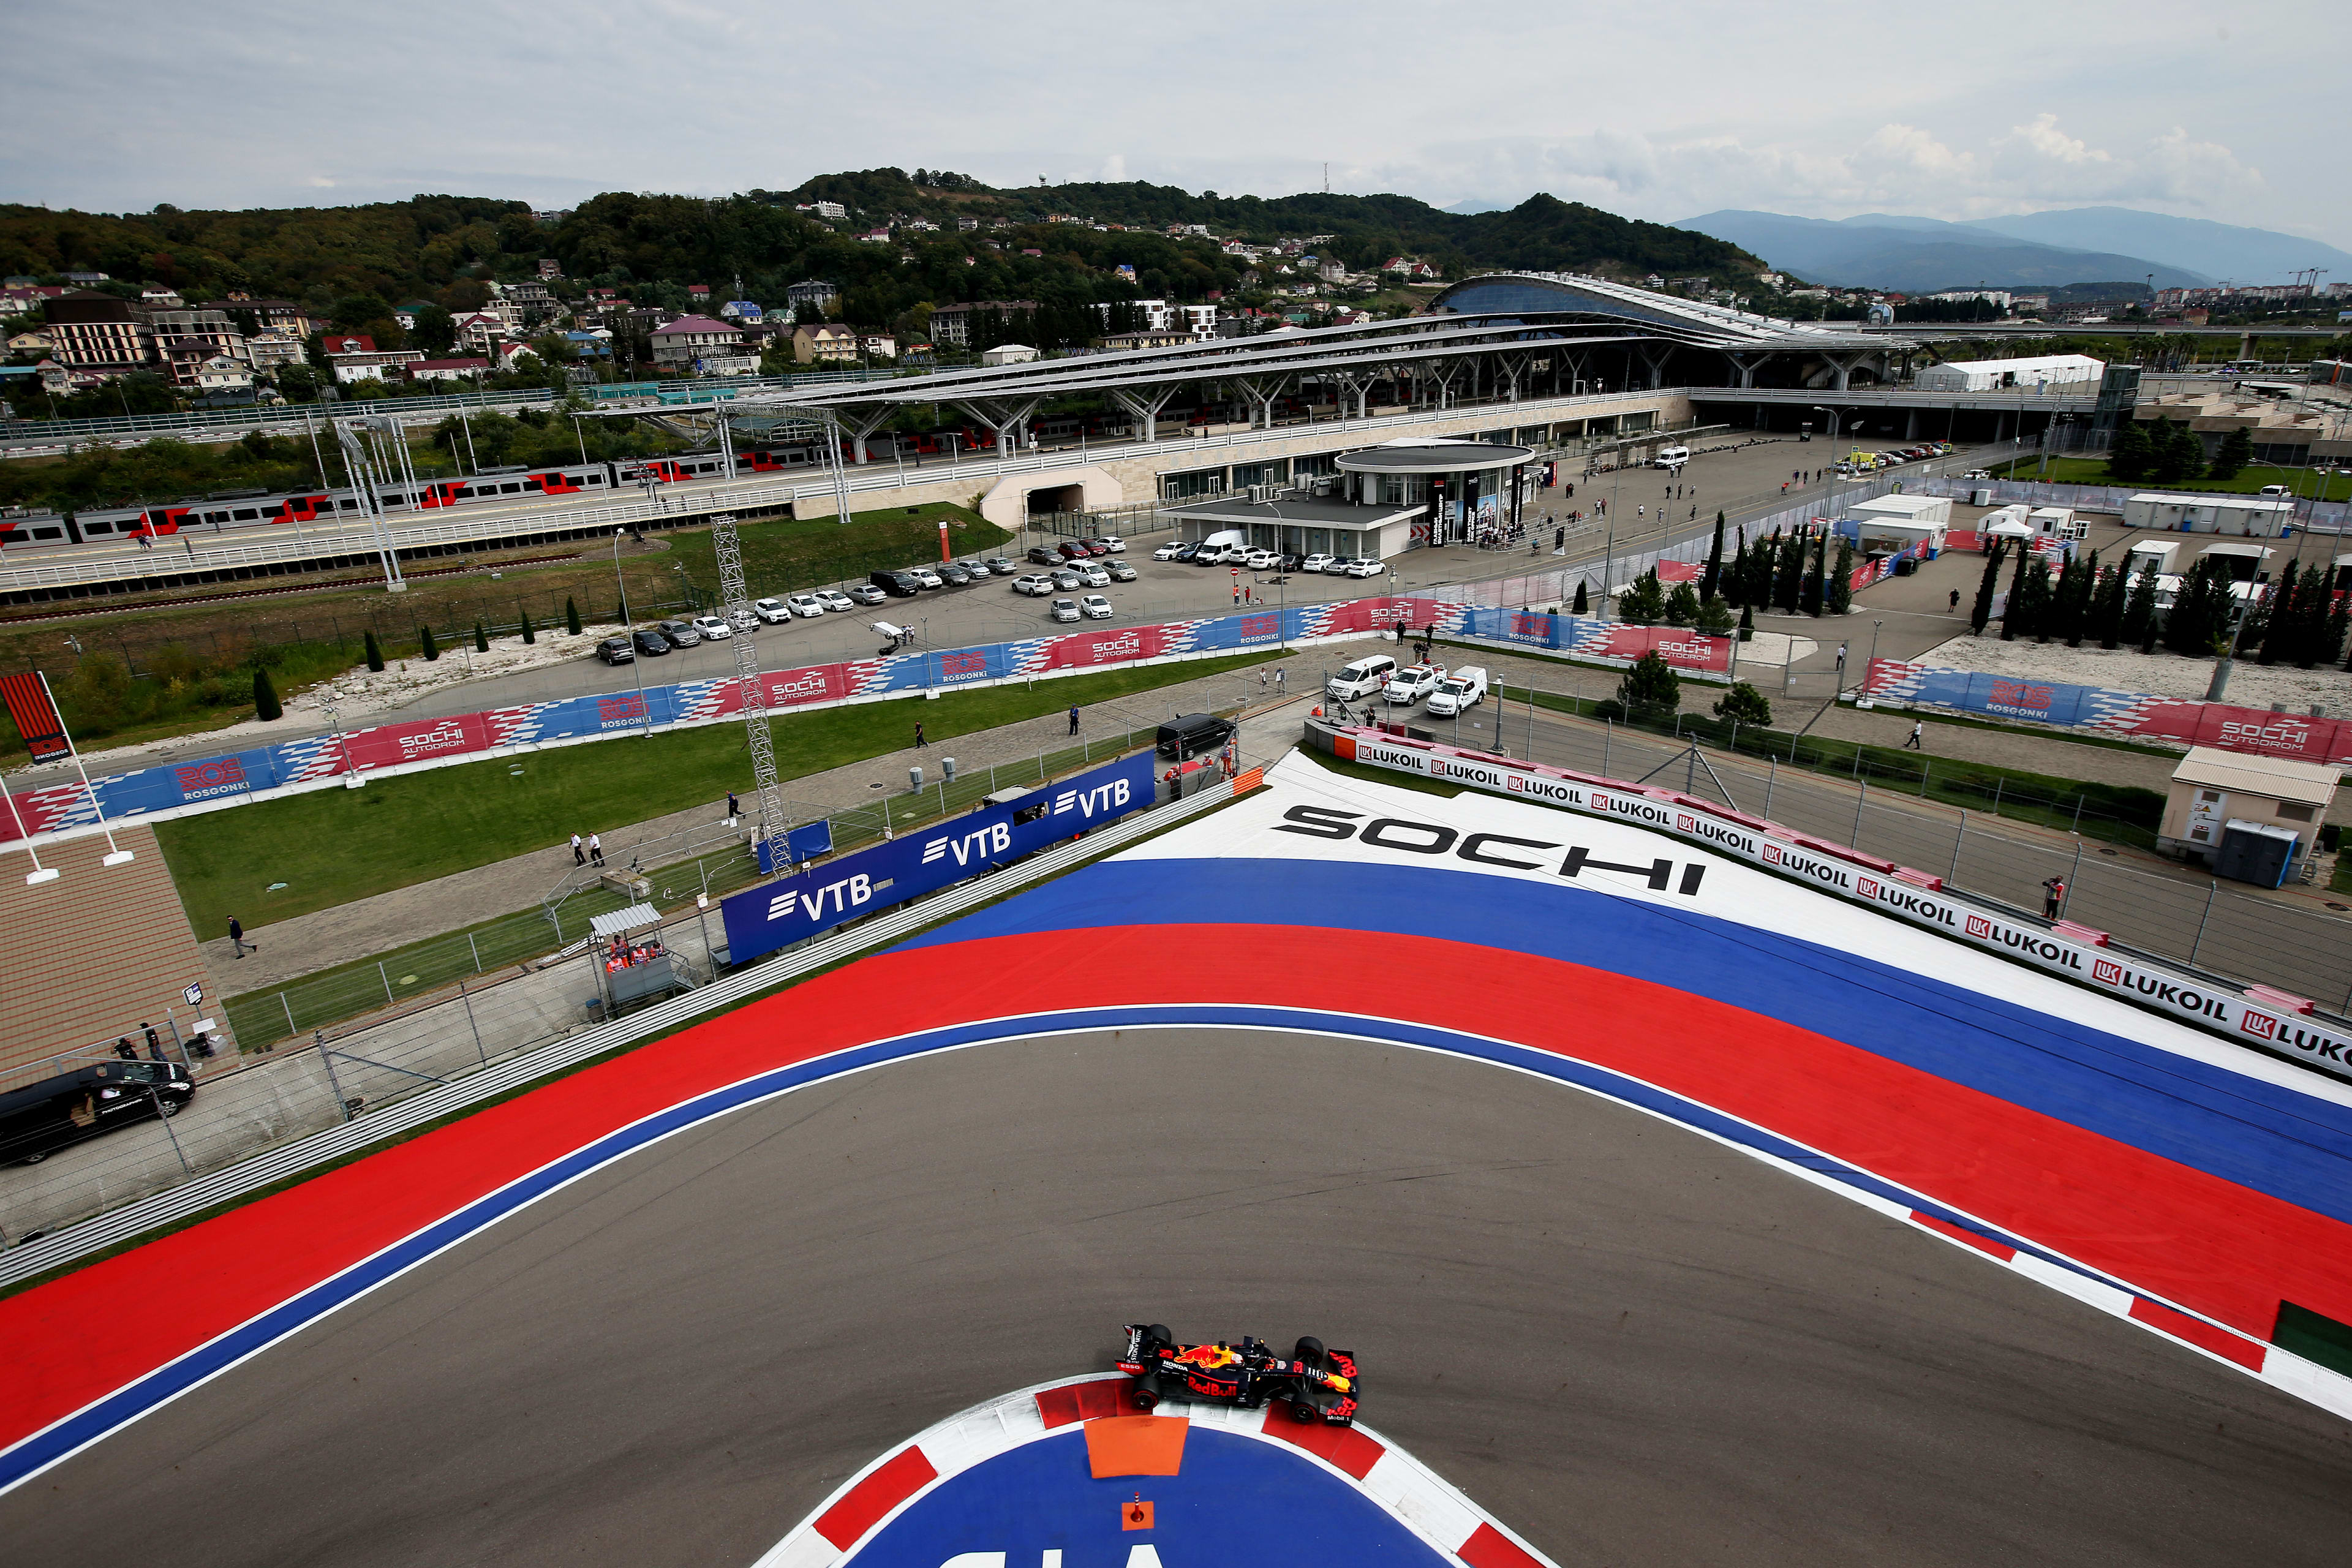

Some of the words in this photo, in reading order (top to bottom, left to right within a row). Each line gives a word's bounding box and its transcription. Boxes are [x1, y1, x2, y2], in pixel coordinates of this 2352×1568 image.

[1371, 608, 1413, 618] SOCHI
[1092, 638, 1139, 652] SOCHI
[1241, 633, 1279, 644] ROSGONKI
[1509, 633, 1549, 644] ROSGONKI
[1659, 641, 1711, 655] SOCHI
[1093, 648, 1140, 659] AUTODROM
[1657, 651, 1710, 662] AUTODROM
[771, 678, 826, 695] SOCHI
[943, 671, 987, 682] ROSGONKI
[774, 688, 827, 701] AUTODROM
[1988, 680, 2055, 709] ROS
[1986, 703, 2048, 719] ROSGONKI
[399, 728, 463, 748] SOCHI
[2218, 734, 2303, 751] AUTODROM
[2221, 722, 2308, 743] SOCHI
[402, 739, 465, 755] AUTODROM
[1373, 749, 1423, 769] LUKOIL
[1447, 764, 1501, 785] LUKOIL
[184, 782, 250, 800] ROSGONKI
[1078, 778, 1130, 818] VTB
[1525, 780, 1582, 804] LUKOIL
[1610, 799, 1670, 824] LUKOIL
[950, 821, 1011, 866] VTB
[1695, 821, 1755, 854] LUKOIL
[1269, 805, 1706, 896] SOCHI
[1782, 852, 1849, 888] LUKOIL
[800, 873, 872, 921] VTB
[1879, 886, 1956, 927] LUKOIL
[1991, 925, 2081, 970] LUKOIL
[2122, 971, 2228, 1022] LUKOIL
[2276, 1023, 2352, 1068] LUK
[1163, 1360, 1188, 1371] HONDA
